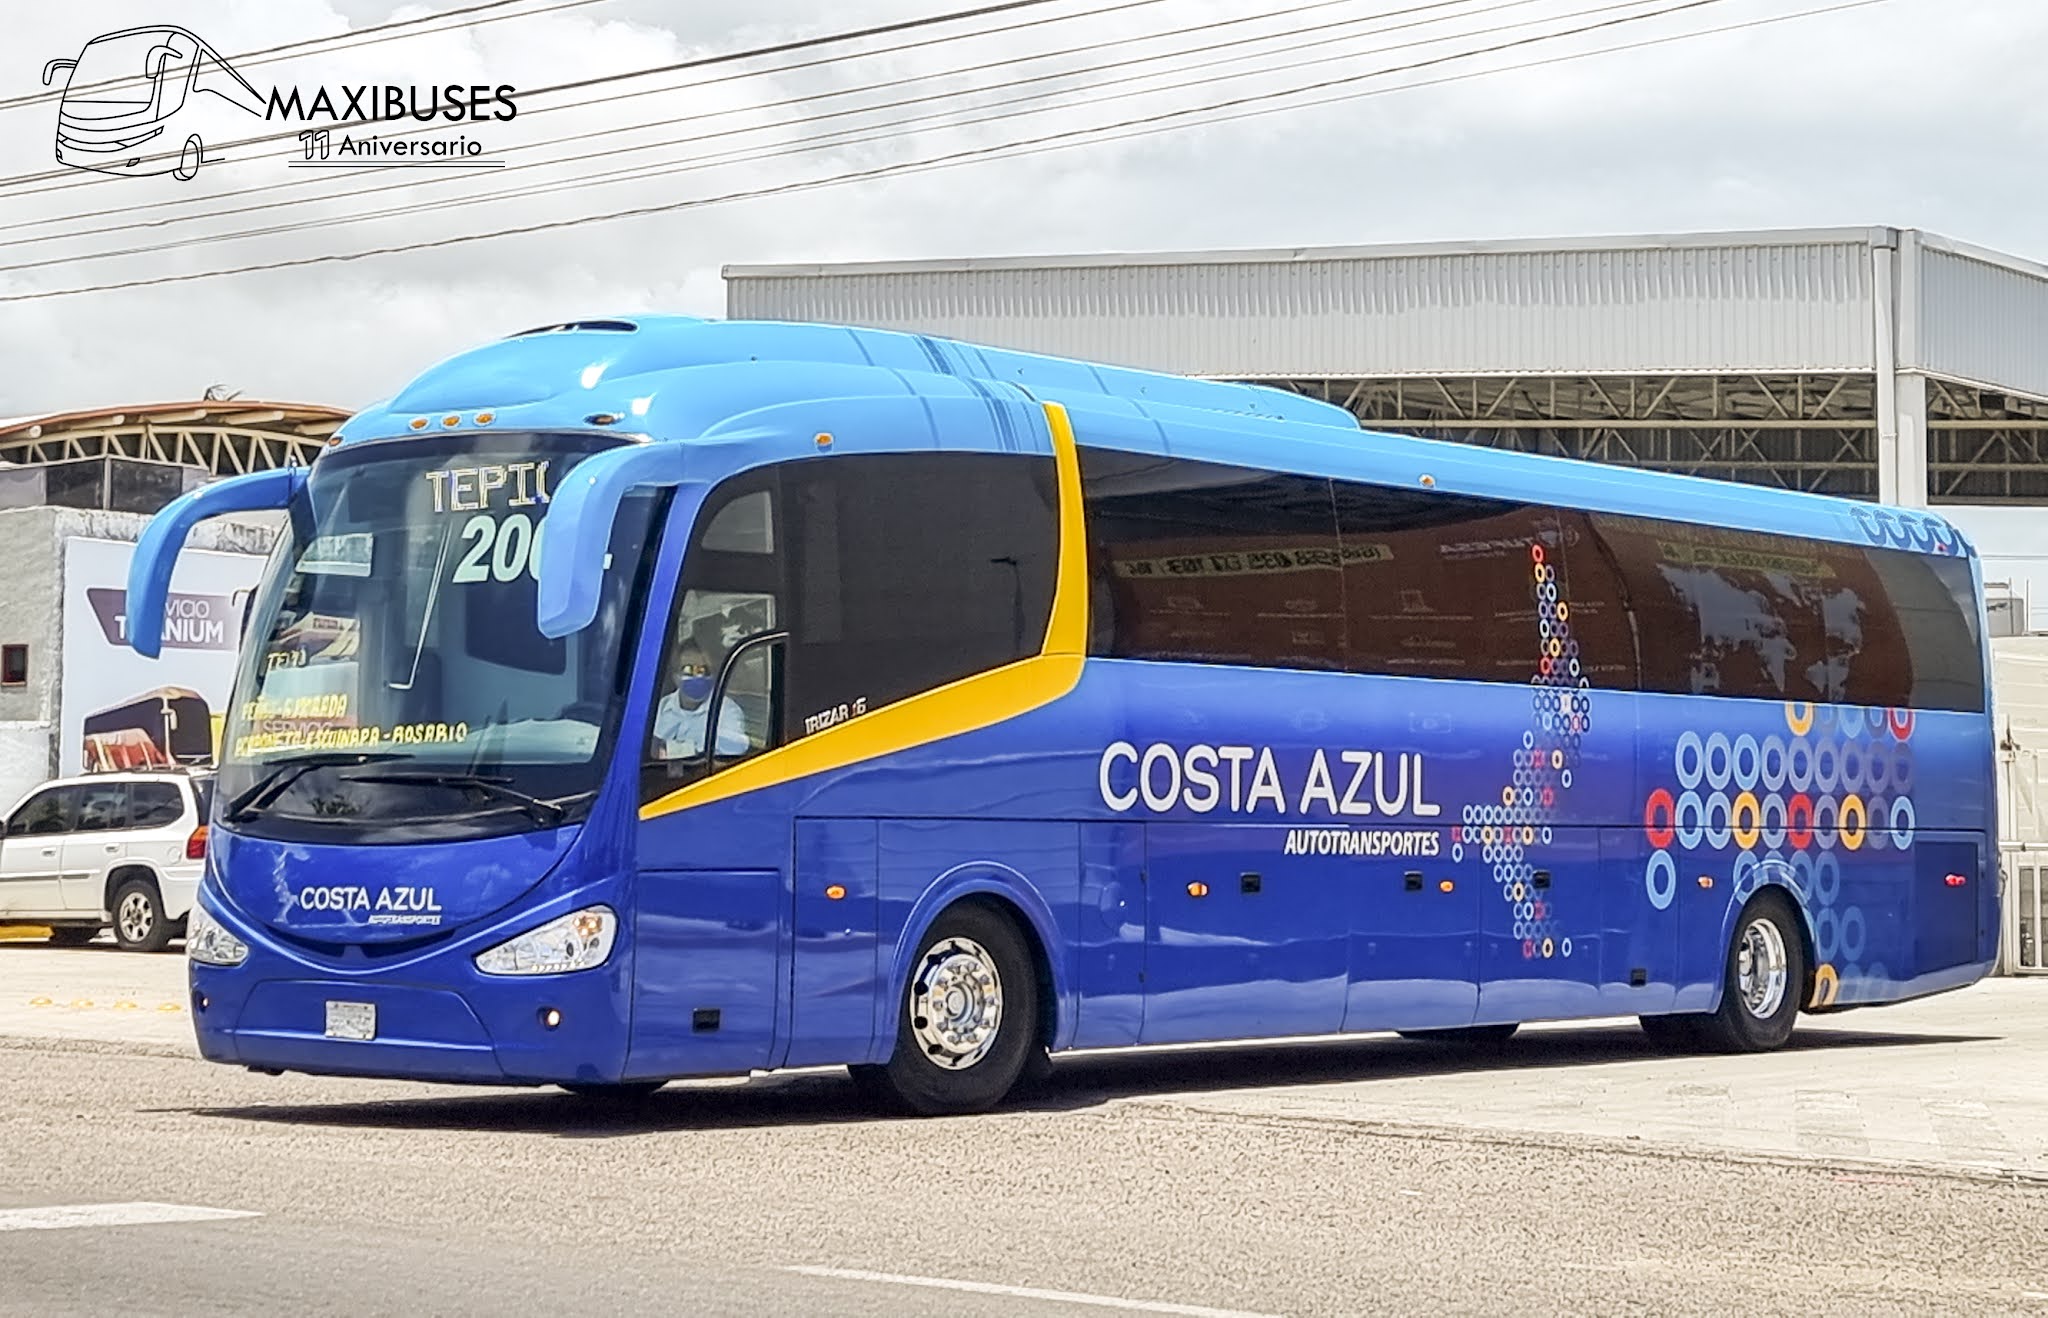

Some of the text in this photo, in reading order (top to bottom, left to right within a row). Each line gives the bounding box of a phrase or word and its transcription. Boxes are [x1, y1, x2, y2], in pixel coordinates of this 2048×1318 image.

[114, 615, 224, 644] TNIUM
[804, 703, 850, 735] IRIZAR
[1099, 741, 1442, 817] COSTA AZUL
[1283, 829, 1440, 857] AUTOTRANSPORTES
[300, 886, 442, 911] COSTA AZUL
